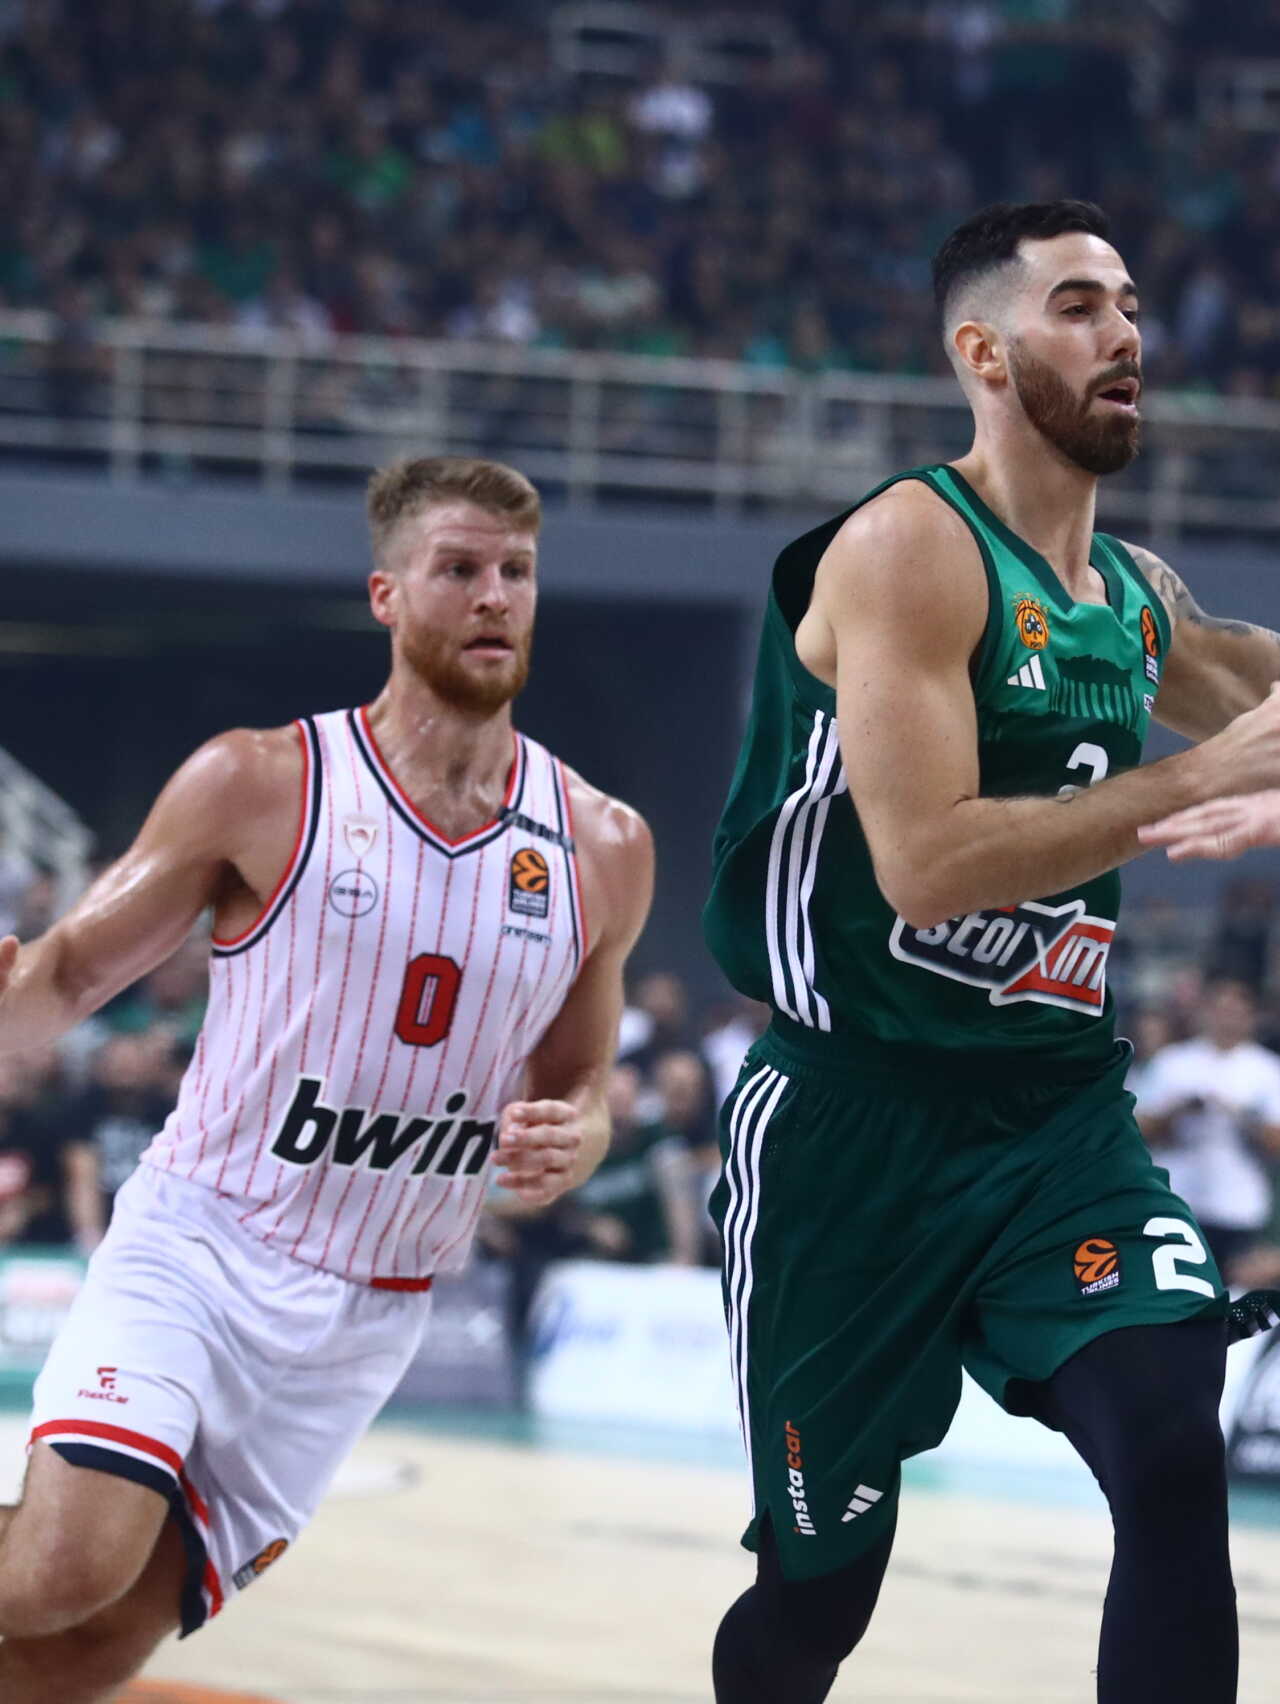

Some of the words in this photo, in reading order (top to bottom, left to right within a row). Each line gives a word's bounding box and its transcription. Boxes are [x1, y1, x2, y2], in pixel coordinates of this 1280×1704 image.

[394, 953, 462, 1047] 0
[271, 1078, 496, 1176] bwin
[1143, 1217, 1215, 1299] 2
[785, 1420, 817, 1536] instacar
